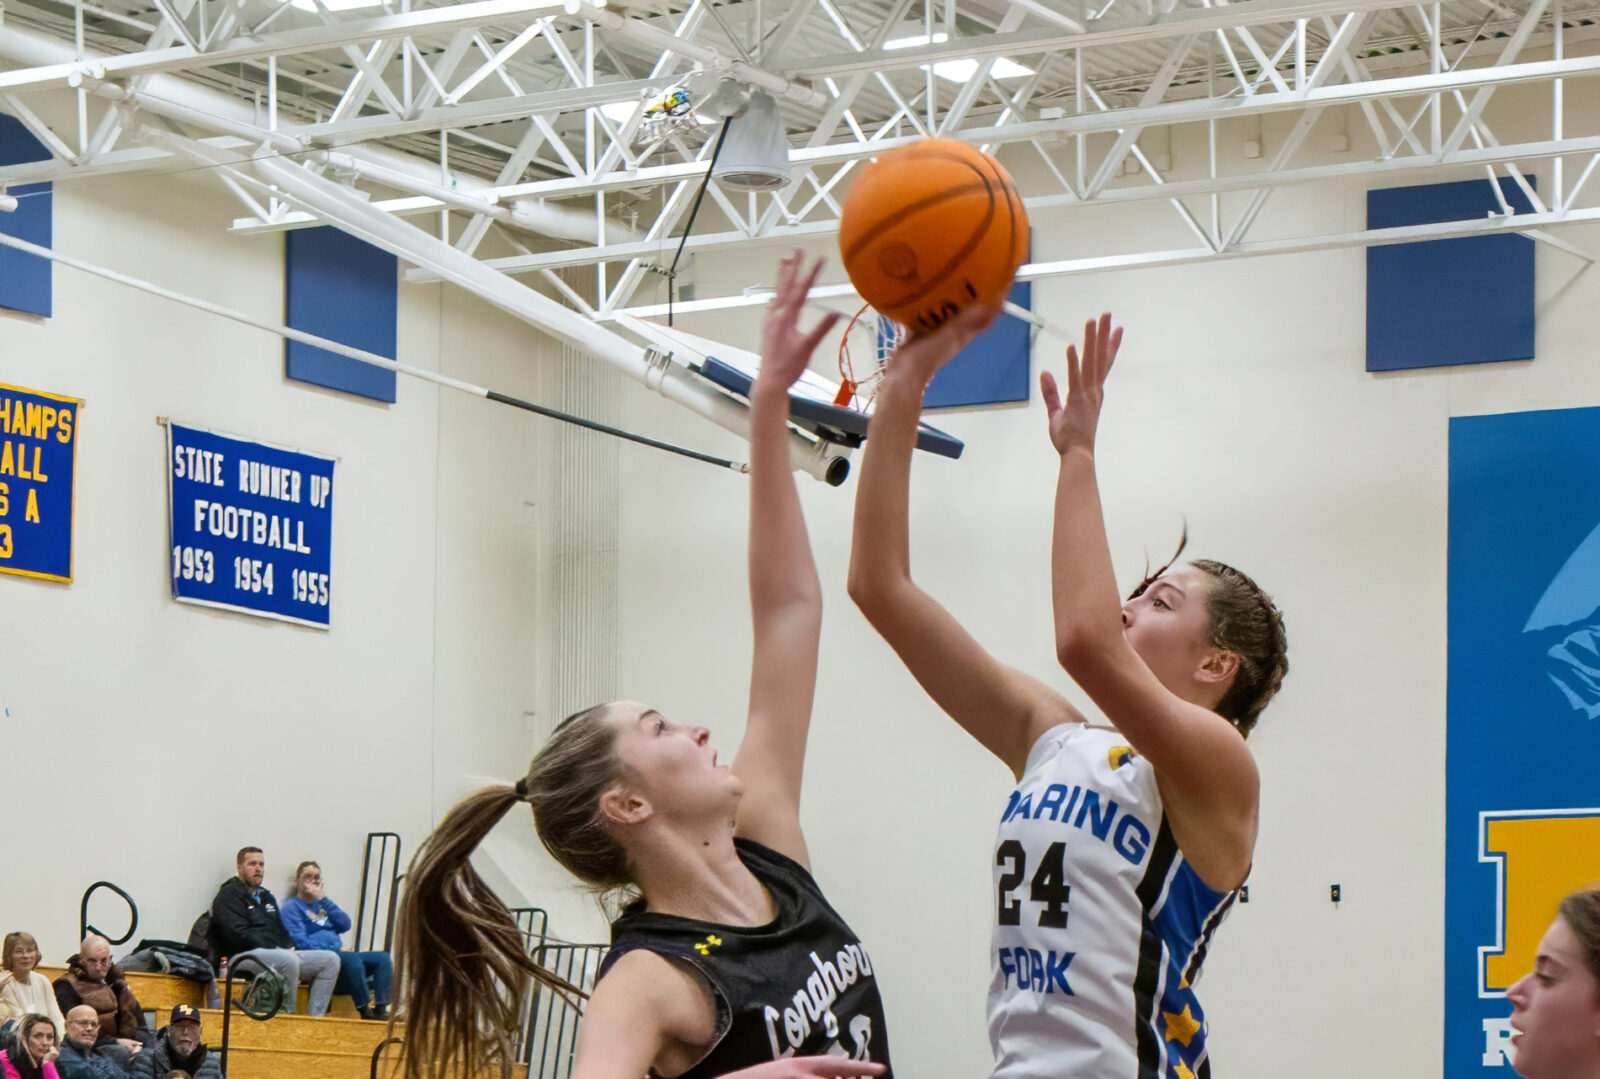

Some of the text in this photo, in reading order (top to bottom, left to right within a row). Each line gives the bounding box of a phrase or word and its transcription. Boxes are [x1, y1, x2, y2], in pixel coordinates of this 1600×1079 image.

[1, 440, 48, 482] ALL
[174, 444, 330, 508] STATE RUNNER UP
[25, 488, 40, 523] A
[194, 499, 311, 554] FOOTBALL
[173, 545, 329, 606] 1953 1954 1955
[996, 839, 1071, 929] 24
